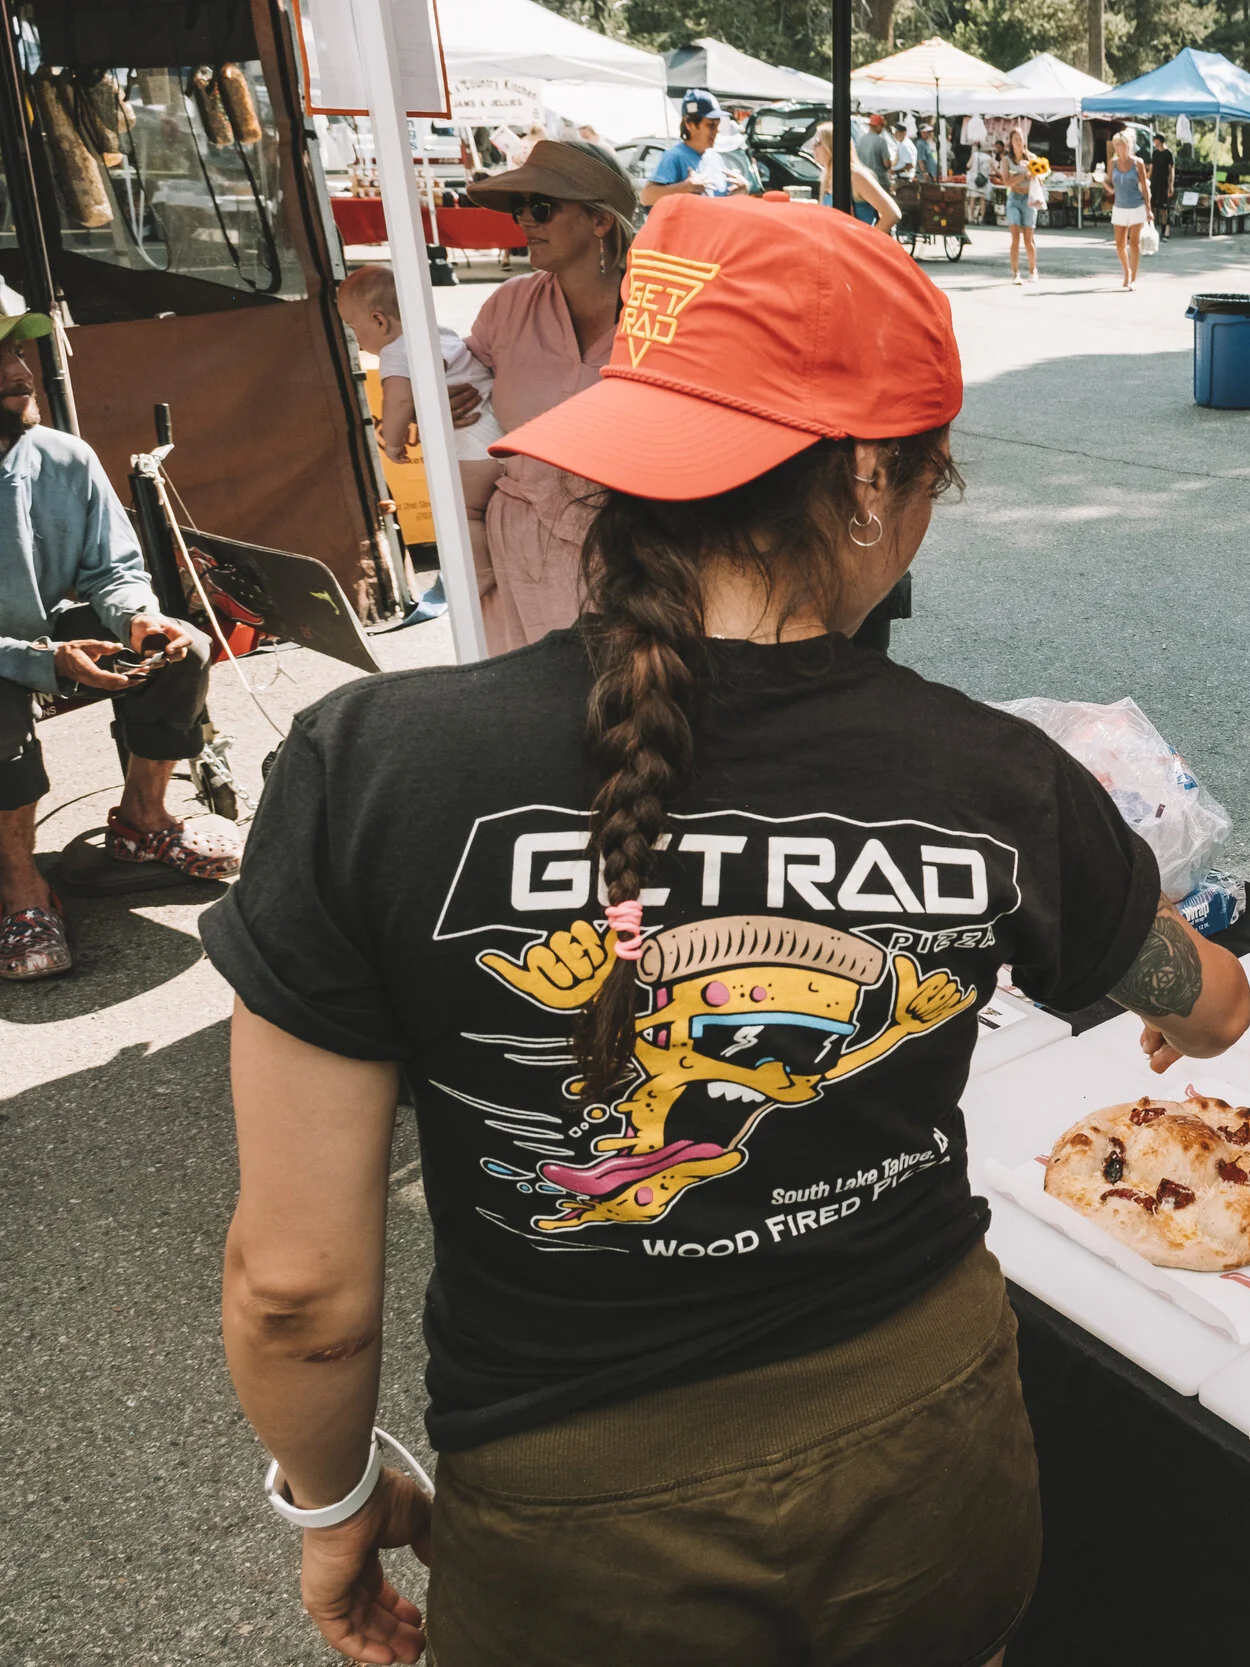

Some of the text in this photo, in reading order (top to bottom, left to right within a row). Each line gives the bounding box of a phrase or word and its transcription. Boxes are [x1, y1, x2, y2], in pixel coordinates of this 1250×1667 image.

[454, 99, 476, 108] JAMS
[627, 281, 688, 316] GET
[621, 307, 678, 345] RAD
[767, 836, 988, 915] RAD
[888, 925, 996, 954] PIZZA
[771, 1181, 830, 1205] South
[835, 1168, 878, 1193] Lake
[642, 1230, 760, 1257] WOOD
[764, 1196, 861, 1243] FIRED
